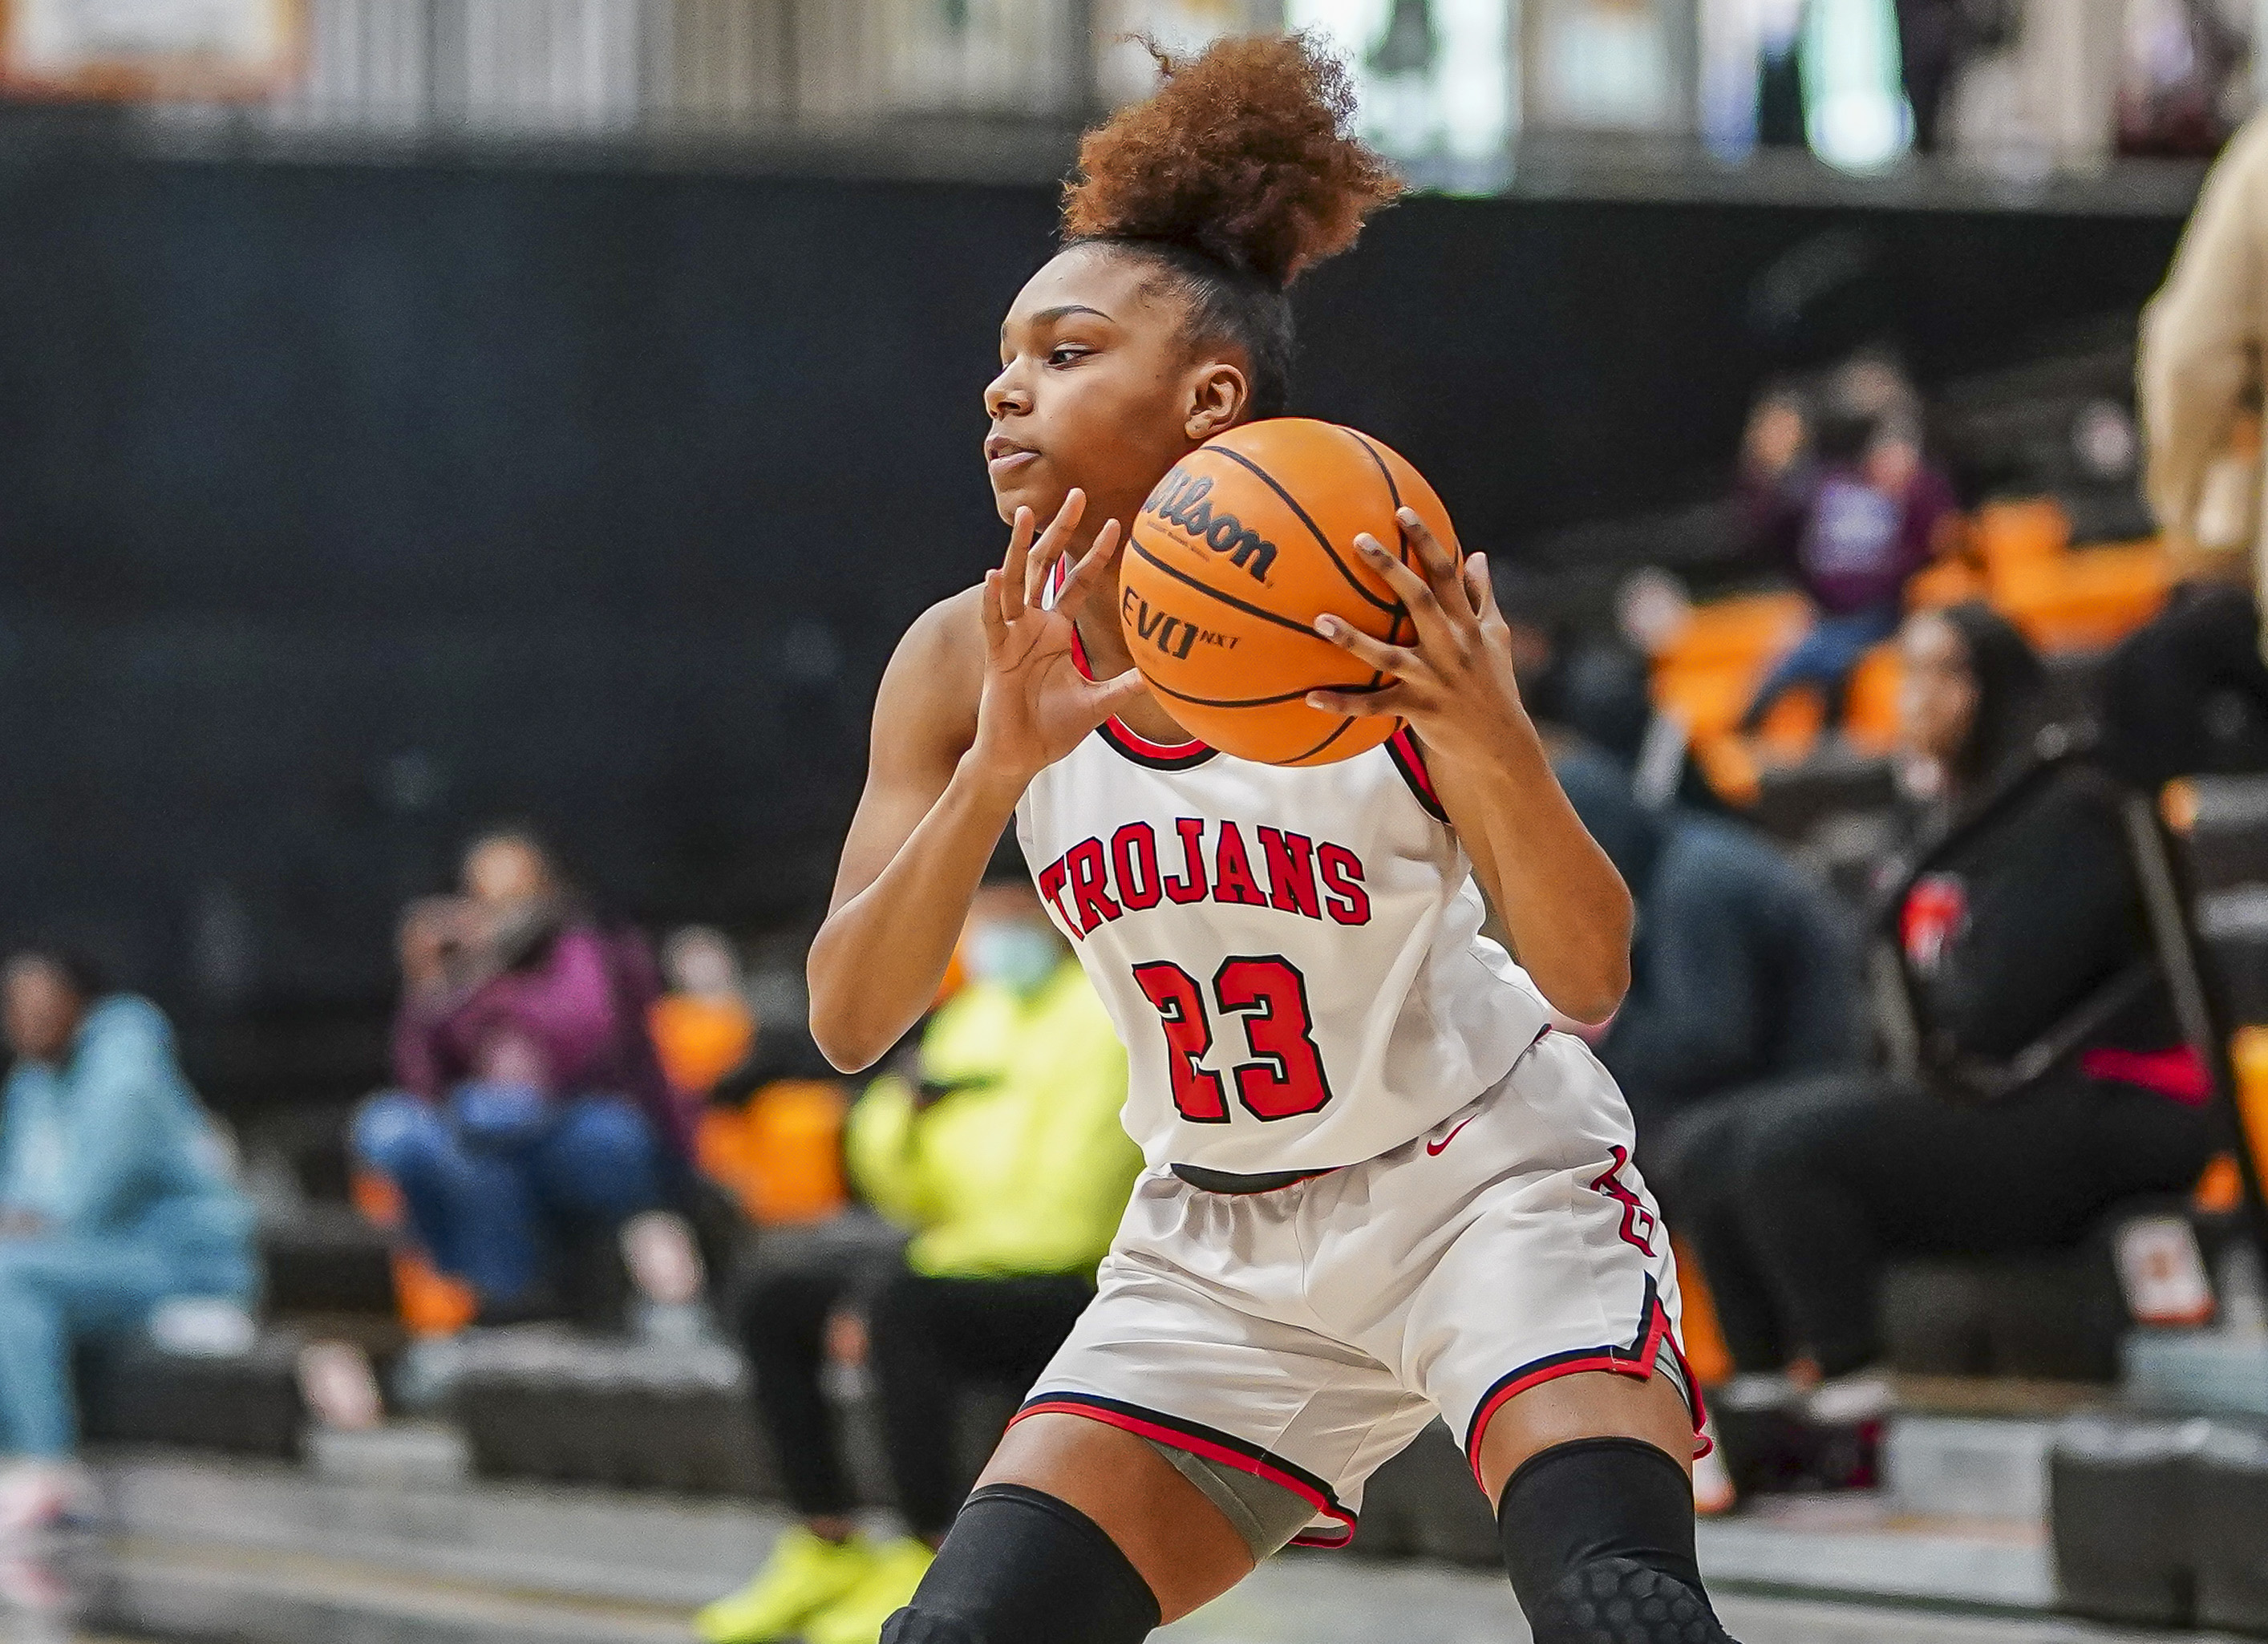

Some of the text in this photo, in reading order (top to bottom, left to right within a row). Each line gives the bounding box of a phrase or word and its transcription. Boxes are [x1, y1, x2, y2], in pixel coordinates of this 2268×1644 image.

[1123, 585, 1199, 660] EVO
[1039, 817, 1371, 941] TROJANS
[1132, 954, 1333, 1124] 23
